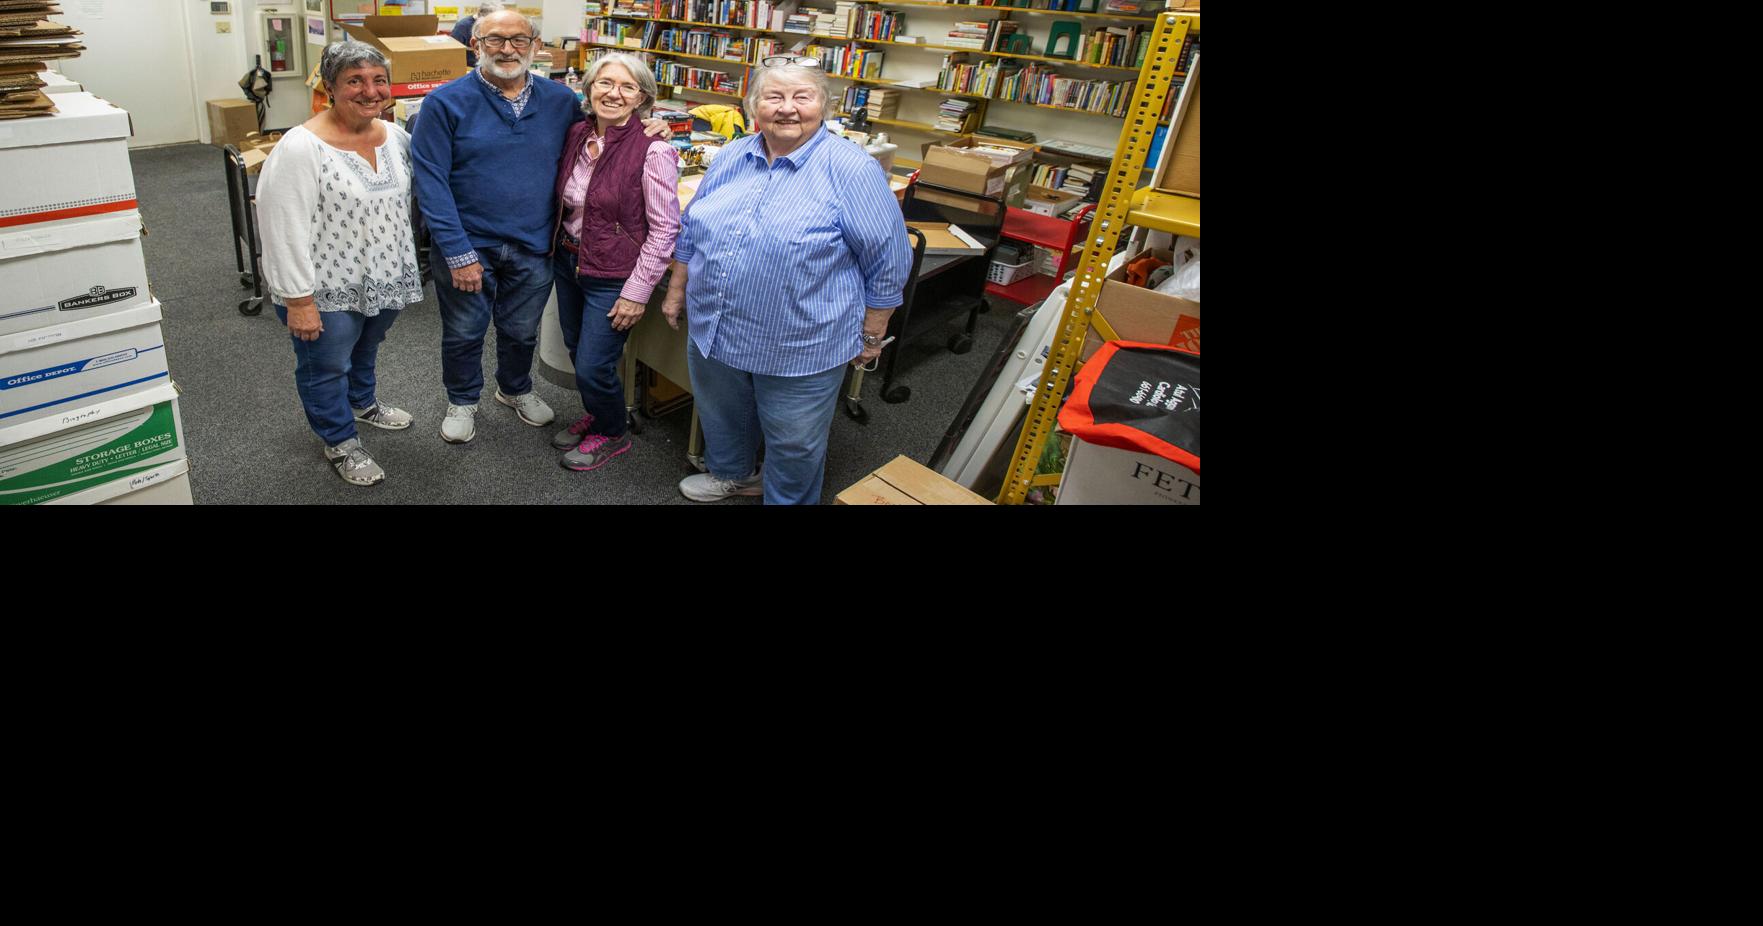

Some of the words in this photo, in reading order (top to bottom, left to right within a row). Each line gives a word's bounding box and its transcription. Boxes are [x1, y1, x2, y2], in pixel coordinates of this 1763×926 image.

[407, 82, 431, 91] Office
[63, 295, 111, 309] BANKERS
[112, 290, 133, 300] BOX
[7, 373, 43, 387] Office
[44, 365, 78, 379] DEPOT
[70, 462, 91, 474] HEAVY
[92, 457, 109, 467] DUTY
[115, 448, 138, 461] LETTER
[141, 442, 160, 453] LEGAL
[160, 438, 173, 448] SIZE
[75, 443, 132, 466] STORAGE
[134, 431, 172, 447] BOXES
